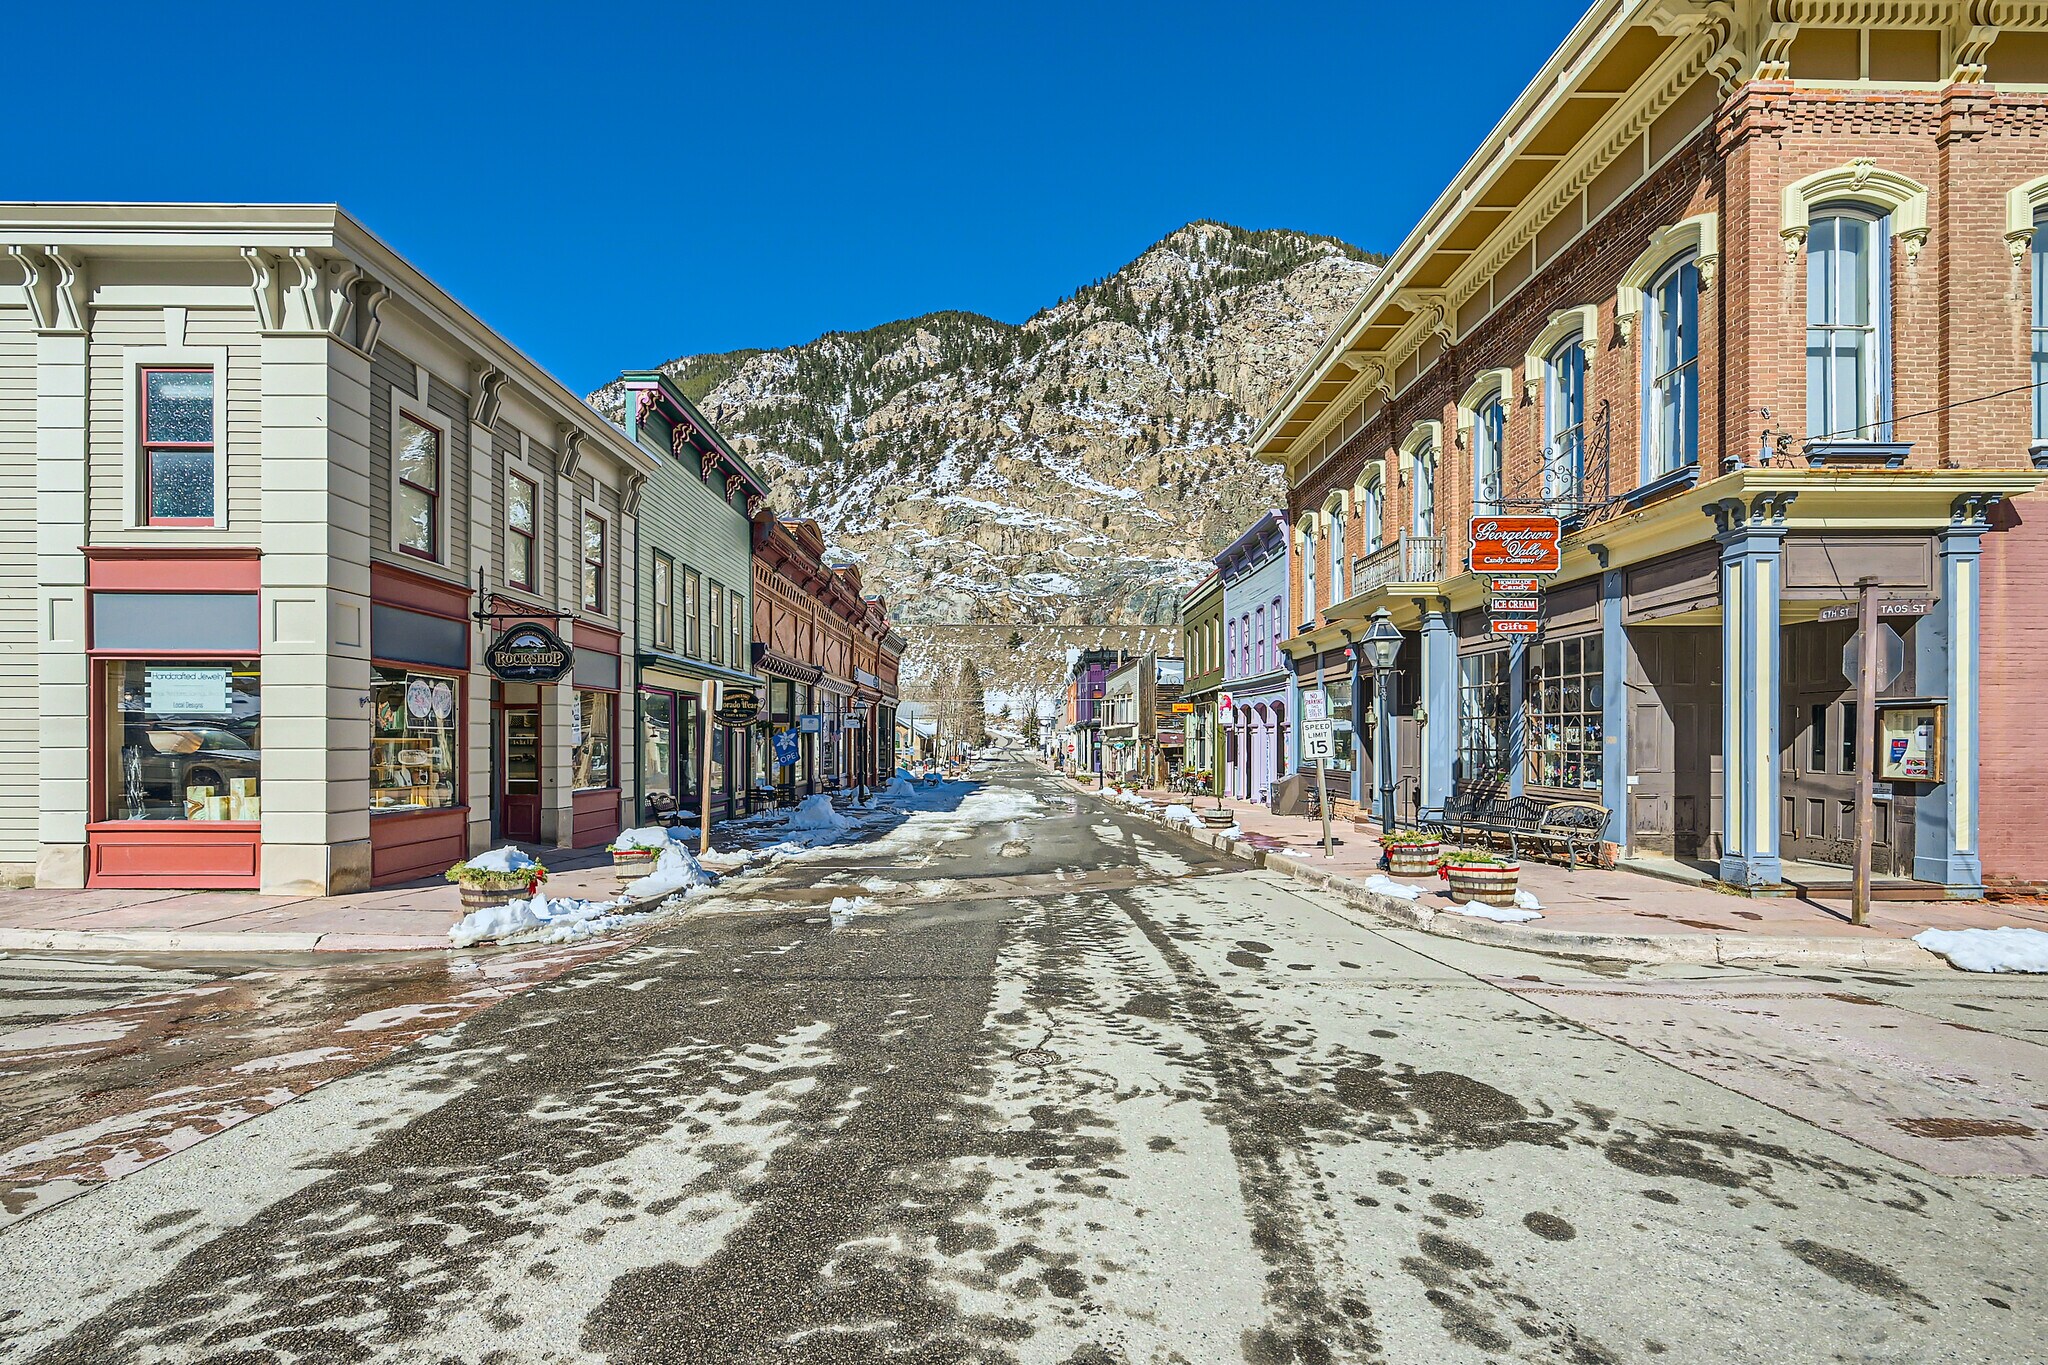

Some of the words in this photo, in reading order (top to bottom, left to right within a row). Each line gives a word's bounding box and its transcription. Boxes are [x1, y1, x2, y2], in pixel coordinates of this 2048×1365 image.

[1475, 521, 1553, 547] Georgetown
[1507, 540, 1550, 560] Valley
[1484, 556, 1506, 564] Candy
[1506, 556, 1536, 564] Company
[1494, 600, 1507, 609] ICE
[1508, 600, 1535, 609] CREAM
[1880, 604, 1908, 614] TAOS
[1912, 604, 1927, 613] ST
[1839, 607, 1850, 617] ST
[1497, 622, 1528, 631] Gifts
[495, 651, 528, 667] ROCK
[528, 651, 565, 667] SHOP
[152, 672, 196, 680] Handcrafted
[197, 672, 225, 682] Jewelry
[185, 701, 204, 709] Designs
[1310, 740, 1328, 755] 15
